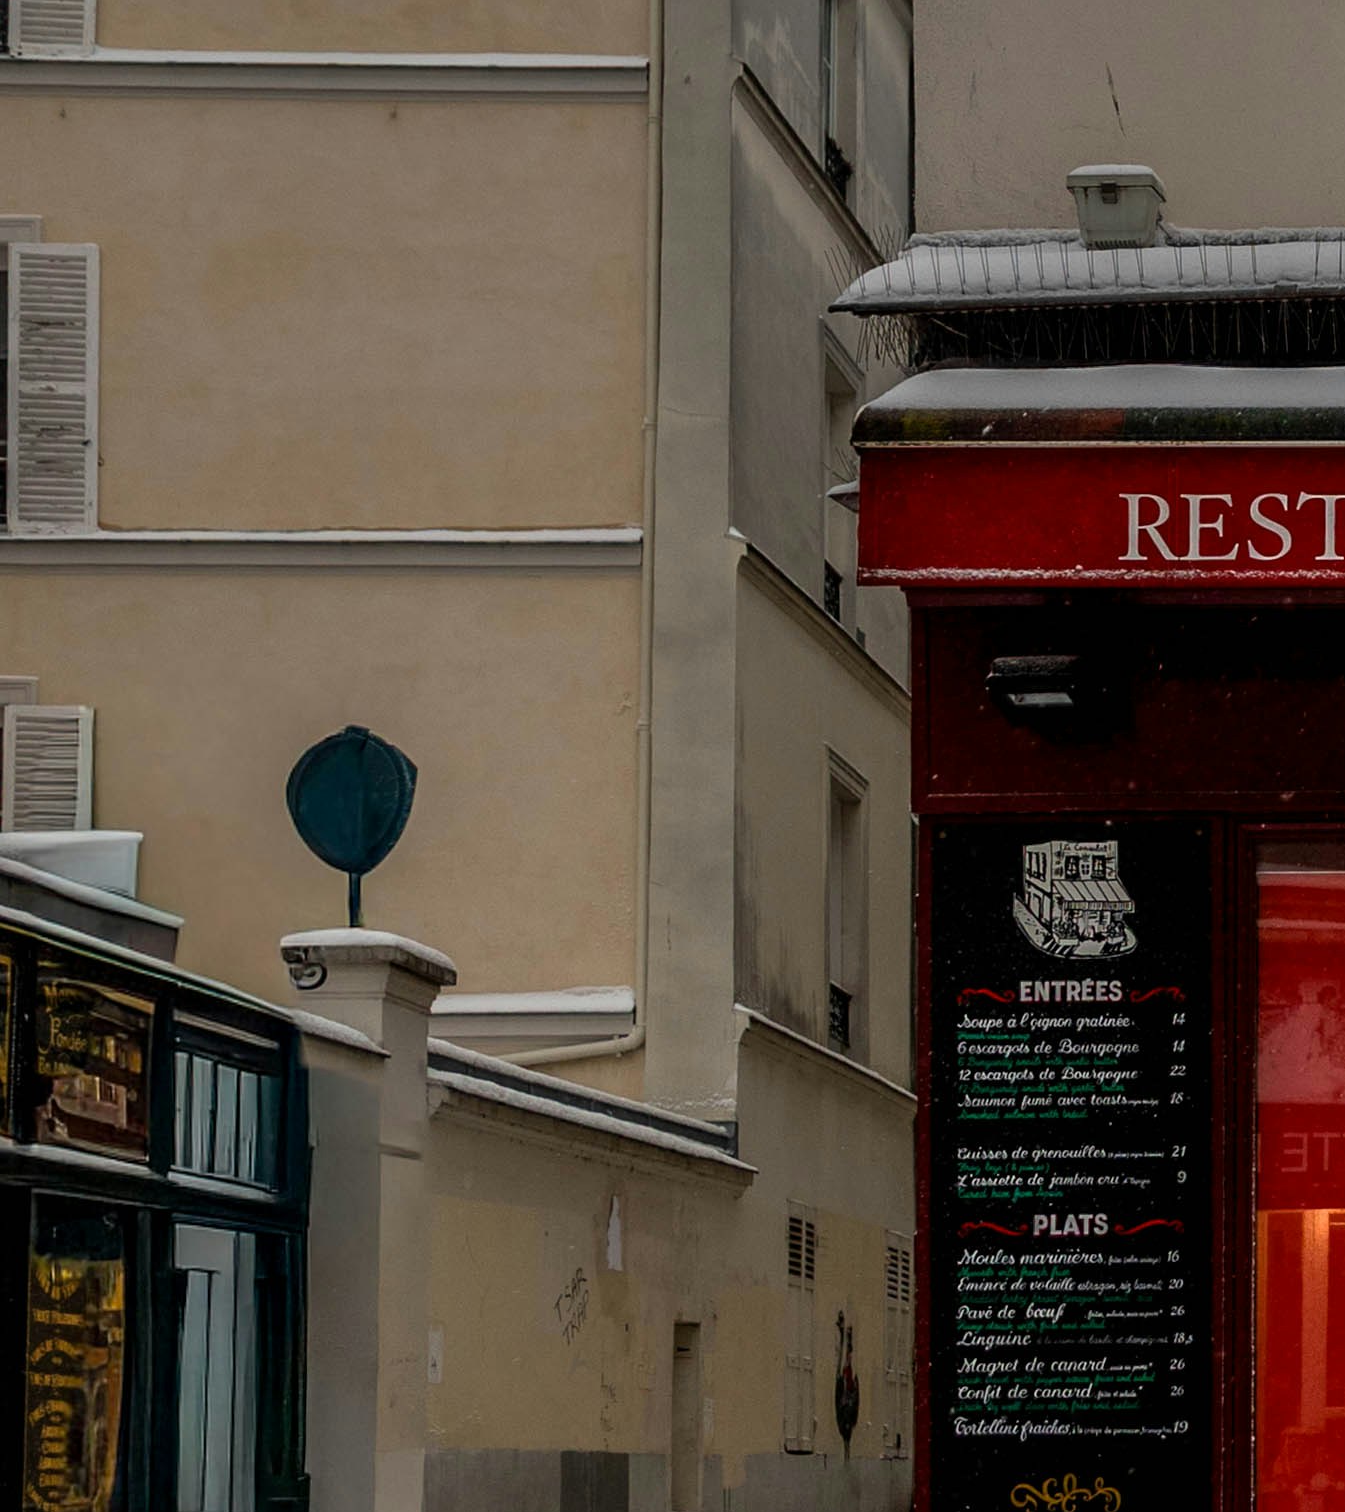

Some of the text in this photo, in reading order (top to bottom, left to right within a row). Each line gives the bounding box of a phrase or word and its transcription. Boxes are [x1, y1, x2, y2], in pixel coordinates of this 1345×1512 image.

[1020, 978, 1123, 1002] ENTRÉES
[957, 1014, 1004, 1032] Soupe
[1172, 1013, 1185, 1025] 14
[968, 1039, 1185, 1058] escargots de Bourgogne 14
[959, 1065, 1186, 1084] 12 escargots de Bourgogne 22
[958, 1095, 1016, 1108] Saumon
[1021, 1095, 1052, 1110] fumé
[1057, 1096, 1085, 1106] avec
[1091, 1095, 1127, 1106] toasts
[957, 1146, 1008, 1160] Cuisses
[1012, 1146, 1028, 1159] de
[1032, 1145, 1106, 1162] grenouilles
[1172, 1146, 1186, 1157] 21
[957, 1173, 1023, 1187] L'assiette
[1028, 1173, 1044, 1186] de
[1049, 1173, 1093, 1189] jambon
[1098, 1176, 1119, 1186] cru
[1177, 1171, 1187, 1183] 9
[1033, 1213, 1109, 1236] PLATS
[957, 1248, 1015, 1266] Moules
[1167, 1251, 1180, 1262] 16
[1011, 1277, 1026, 1290] de
[1030, 1277, 1076, 1291] volaille
[1169, 1279, 1183, 1289] 20
[956, 1305, 992, 1319] Pavé
[998, 1303, 1015, 1319] de
[1171, 1306, 1185, 1316] 26
[957, 1331, 1032, 1350] Linguine
[957, 1357, 1019, 1376] Magret
[1025, 1357, 1045, 1372] de
[1051, 1357, 1107, 1372] canard
[1170, 1359, 1185, 1370] 26
[958, 1385, 1001, 1403] Confit
[1008, 1385, 1028, 1399] de
[1034, 1383, 1093, 1399] canard
[1171, 1386, 1184, 1396] 26
[954, 1417, 1019, 1436] Tortellini
[1173, 1421, 1189, 1432] 19
